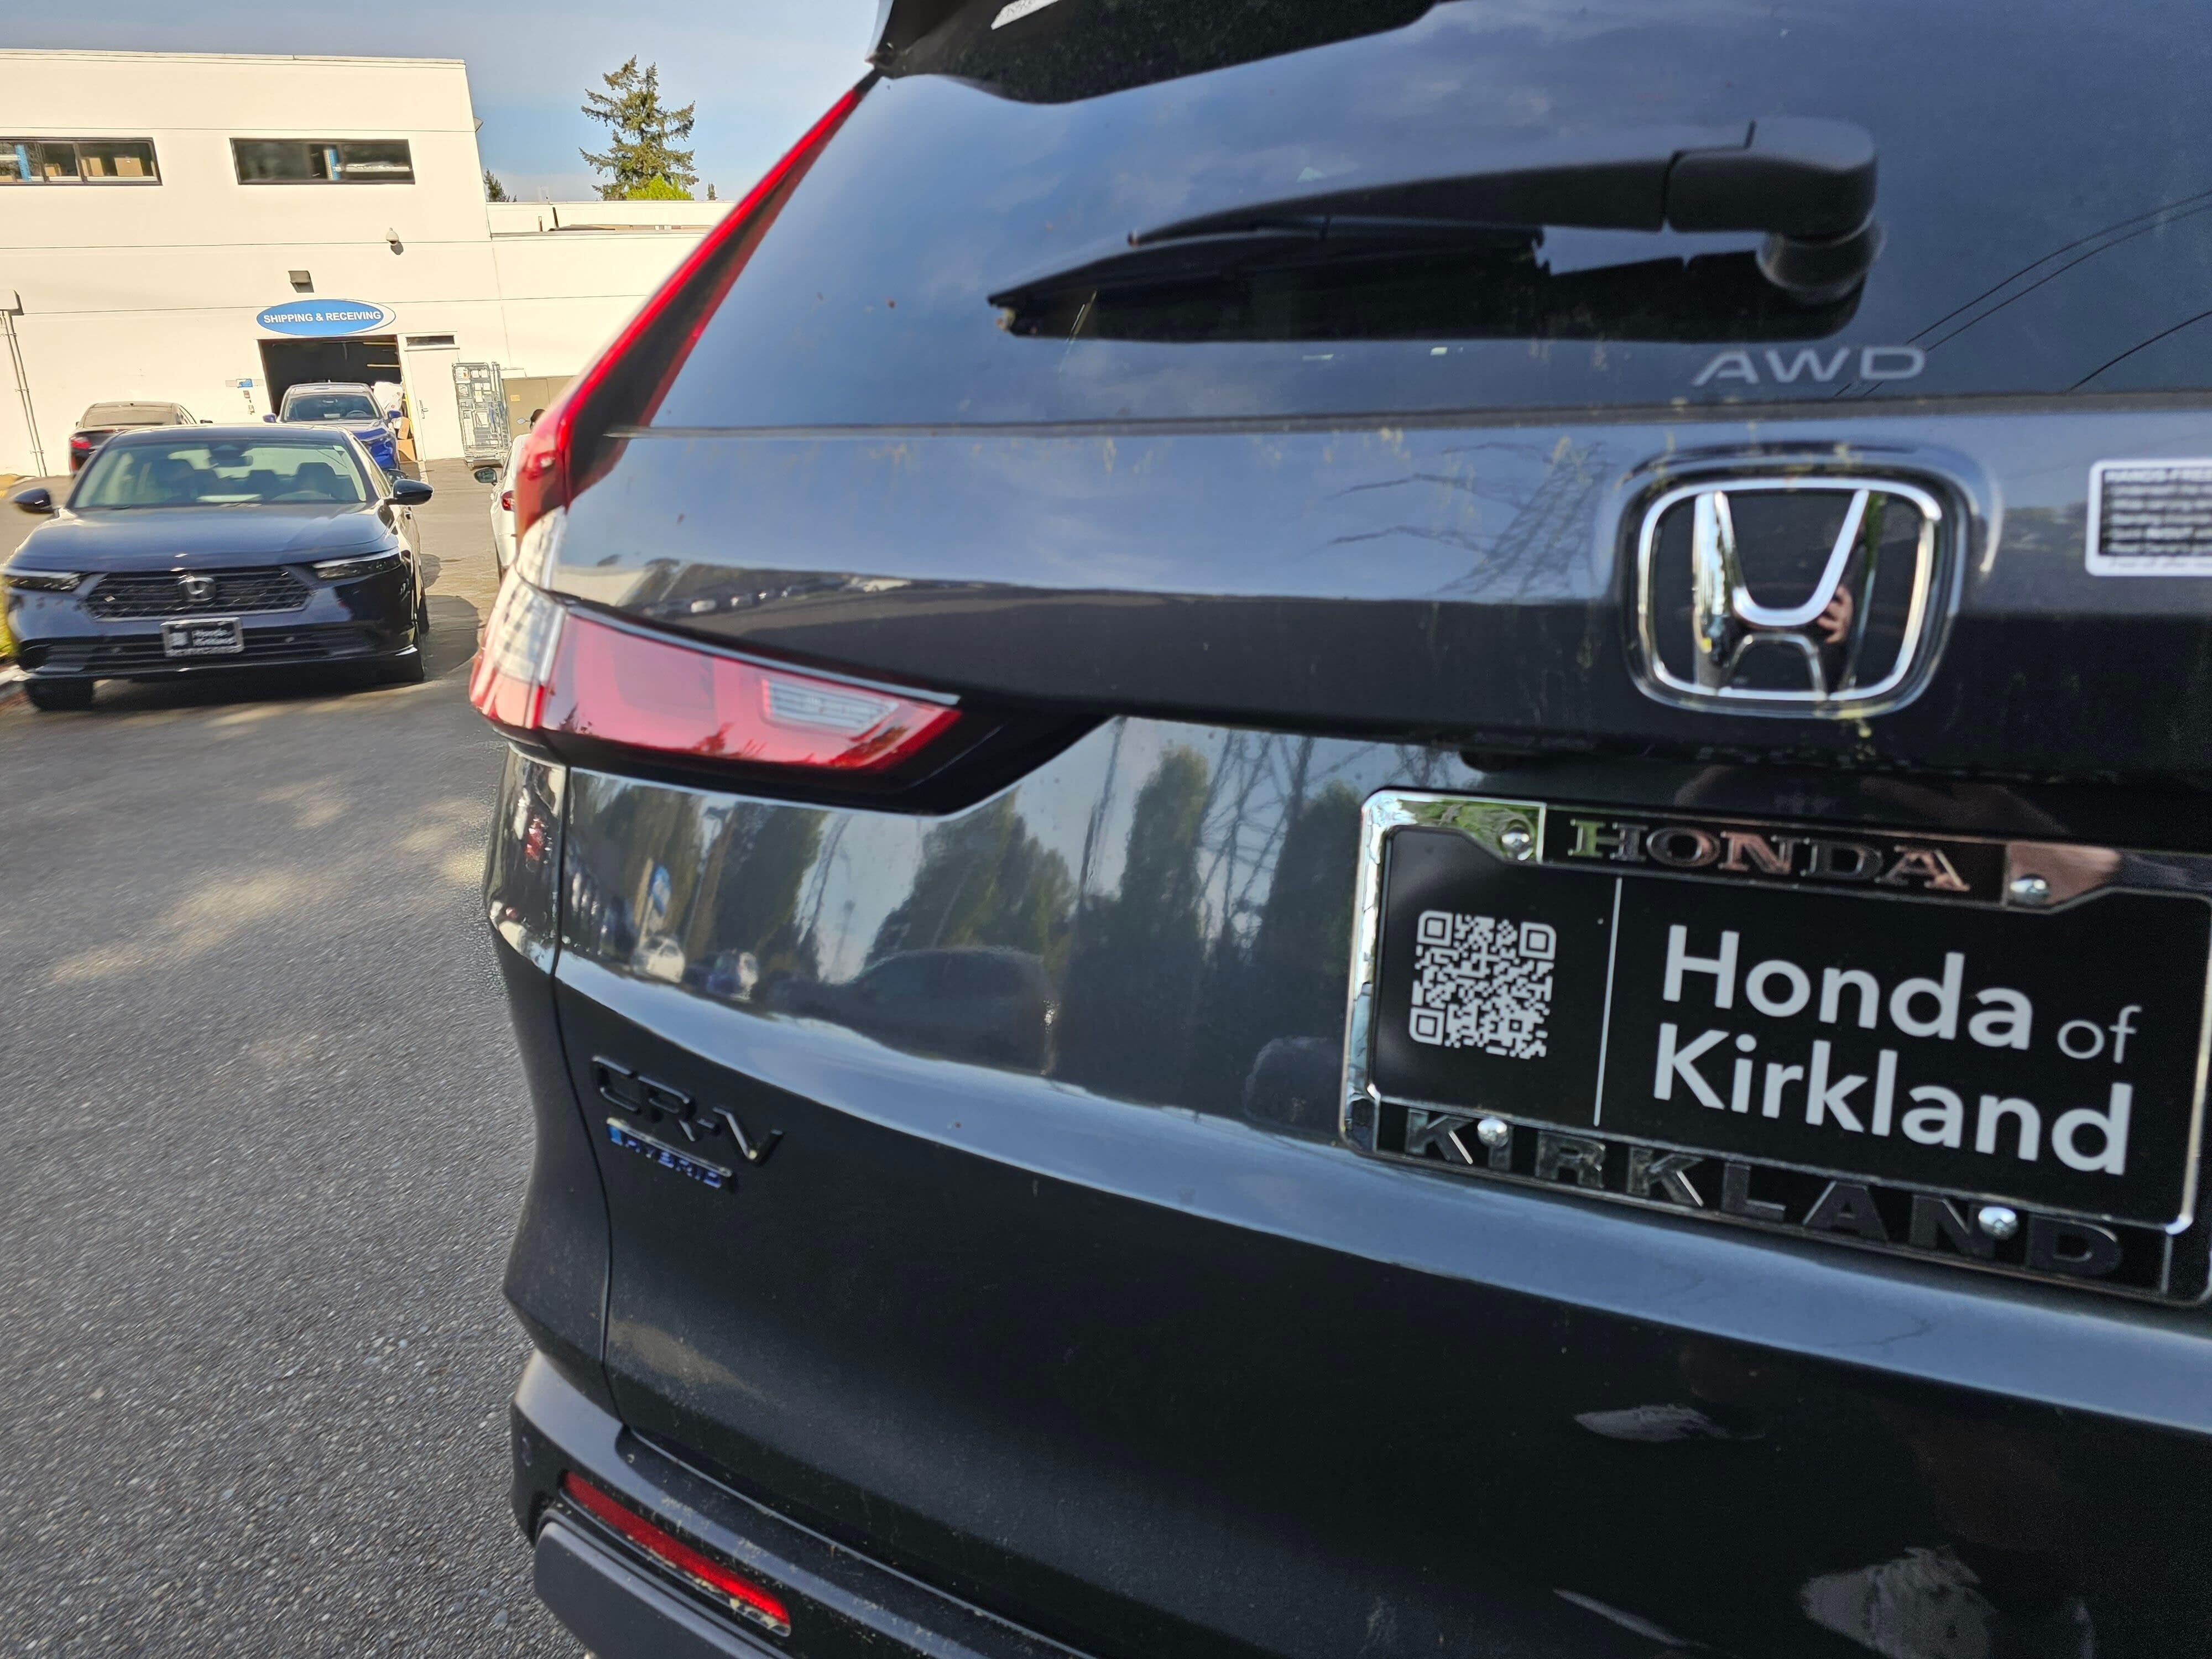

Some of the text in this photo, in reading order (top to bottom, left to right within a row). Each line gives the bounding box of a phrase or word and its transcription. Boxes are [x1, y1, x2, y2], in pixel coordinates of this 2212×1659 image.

[263, 311, 382, 324] SHIPPING & RECEIVING
[1693, 346, 1927, 387] AWD
[1567, 818, 1971, 892] HONDA
[1663, 924, 2143, 1064] Honda of
[591, 1055, 785, 1166] CR-V
[1653, 1022, 2133, 1176] Kirkland
